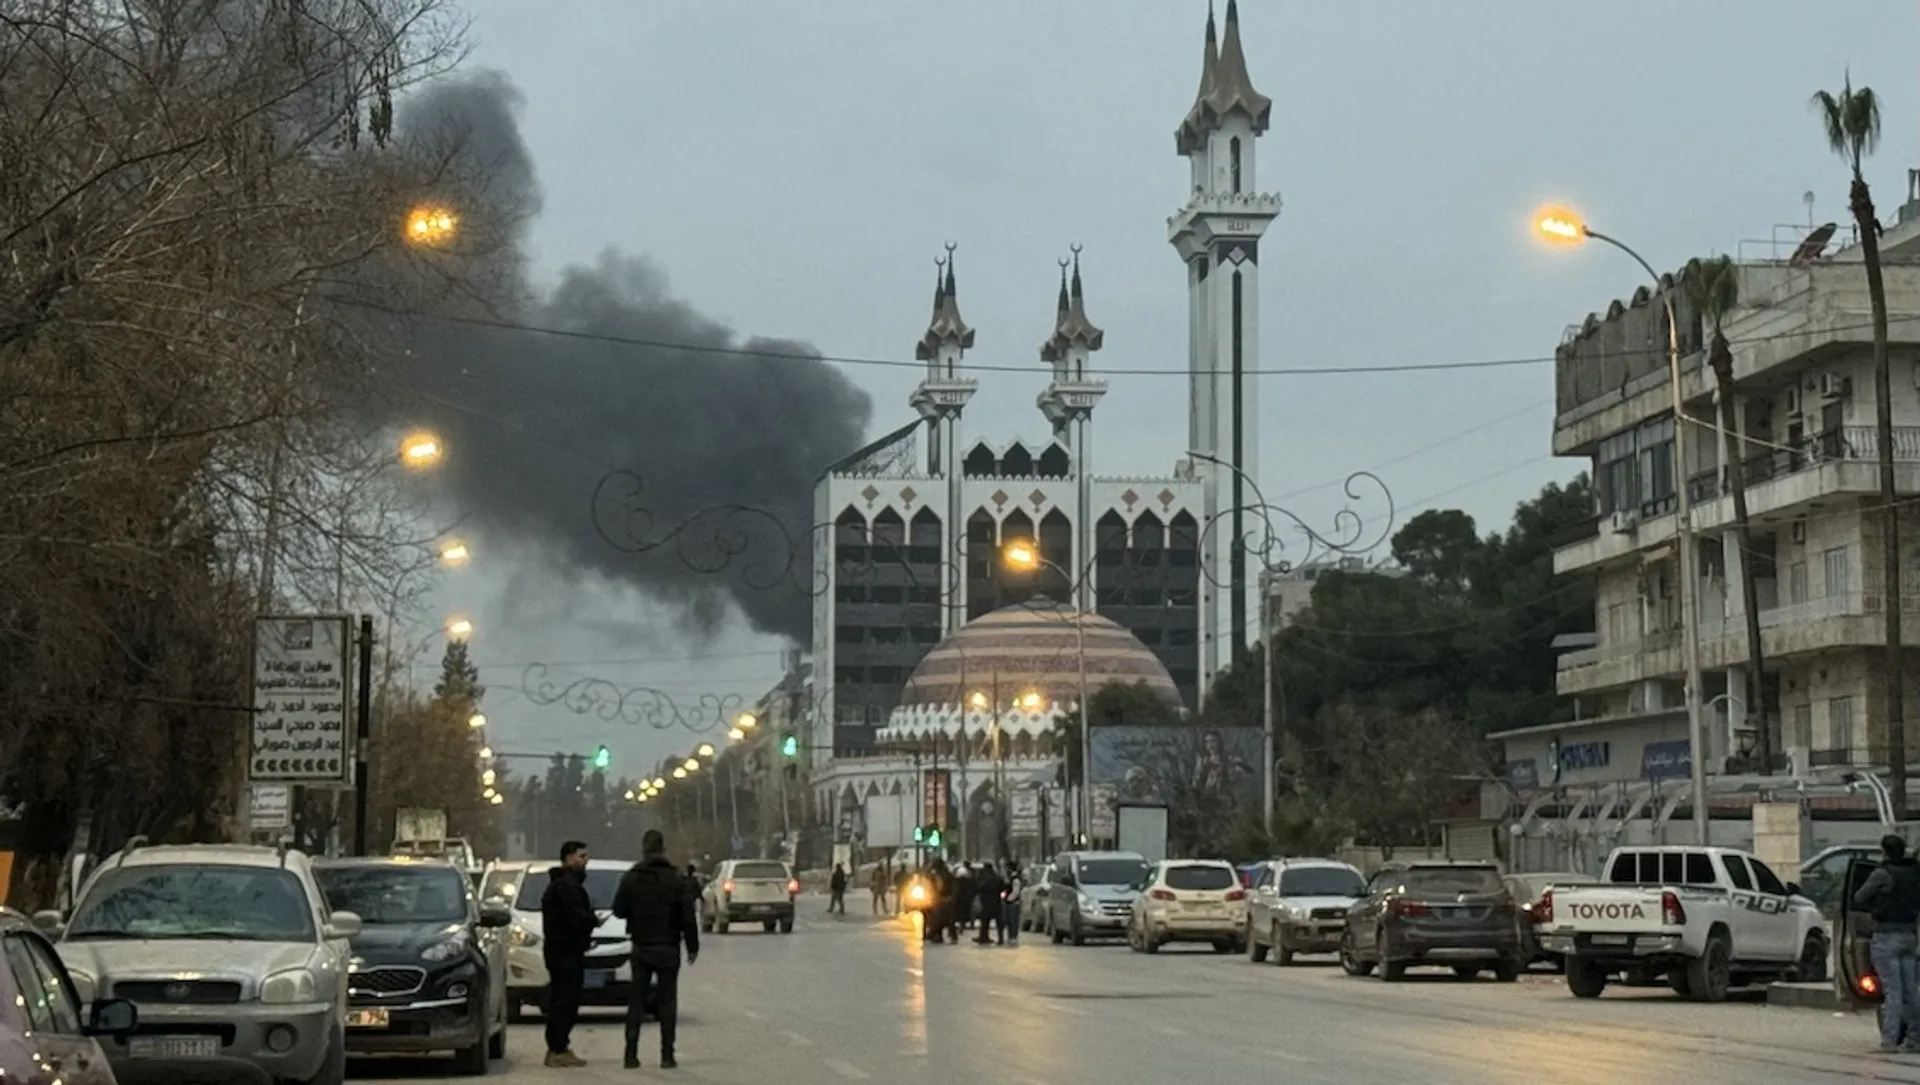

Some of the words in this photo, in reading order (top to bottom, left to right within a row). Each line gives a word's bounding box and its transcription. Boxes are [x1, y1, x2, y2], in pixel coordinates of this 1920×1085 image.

[281, 697, 305, 713] أحمد
[309, 701, 341, 715] محمود
[256, 717, 283, 733] السيد
[318, 719, 341, 731] محمد
[291, 736, 322, 752] الرحمن
[324, 739, 341, 752] عبد
[1568, 903, 1645, 919] TOYOTA
